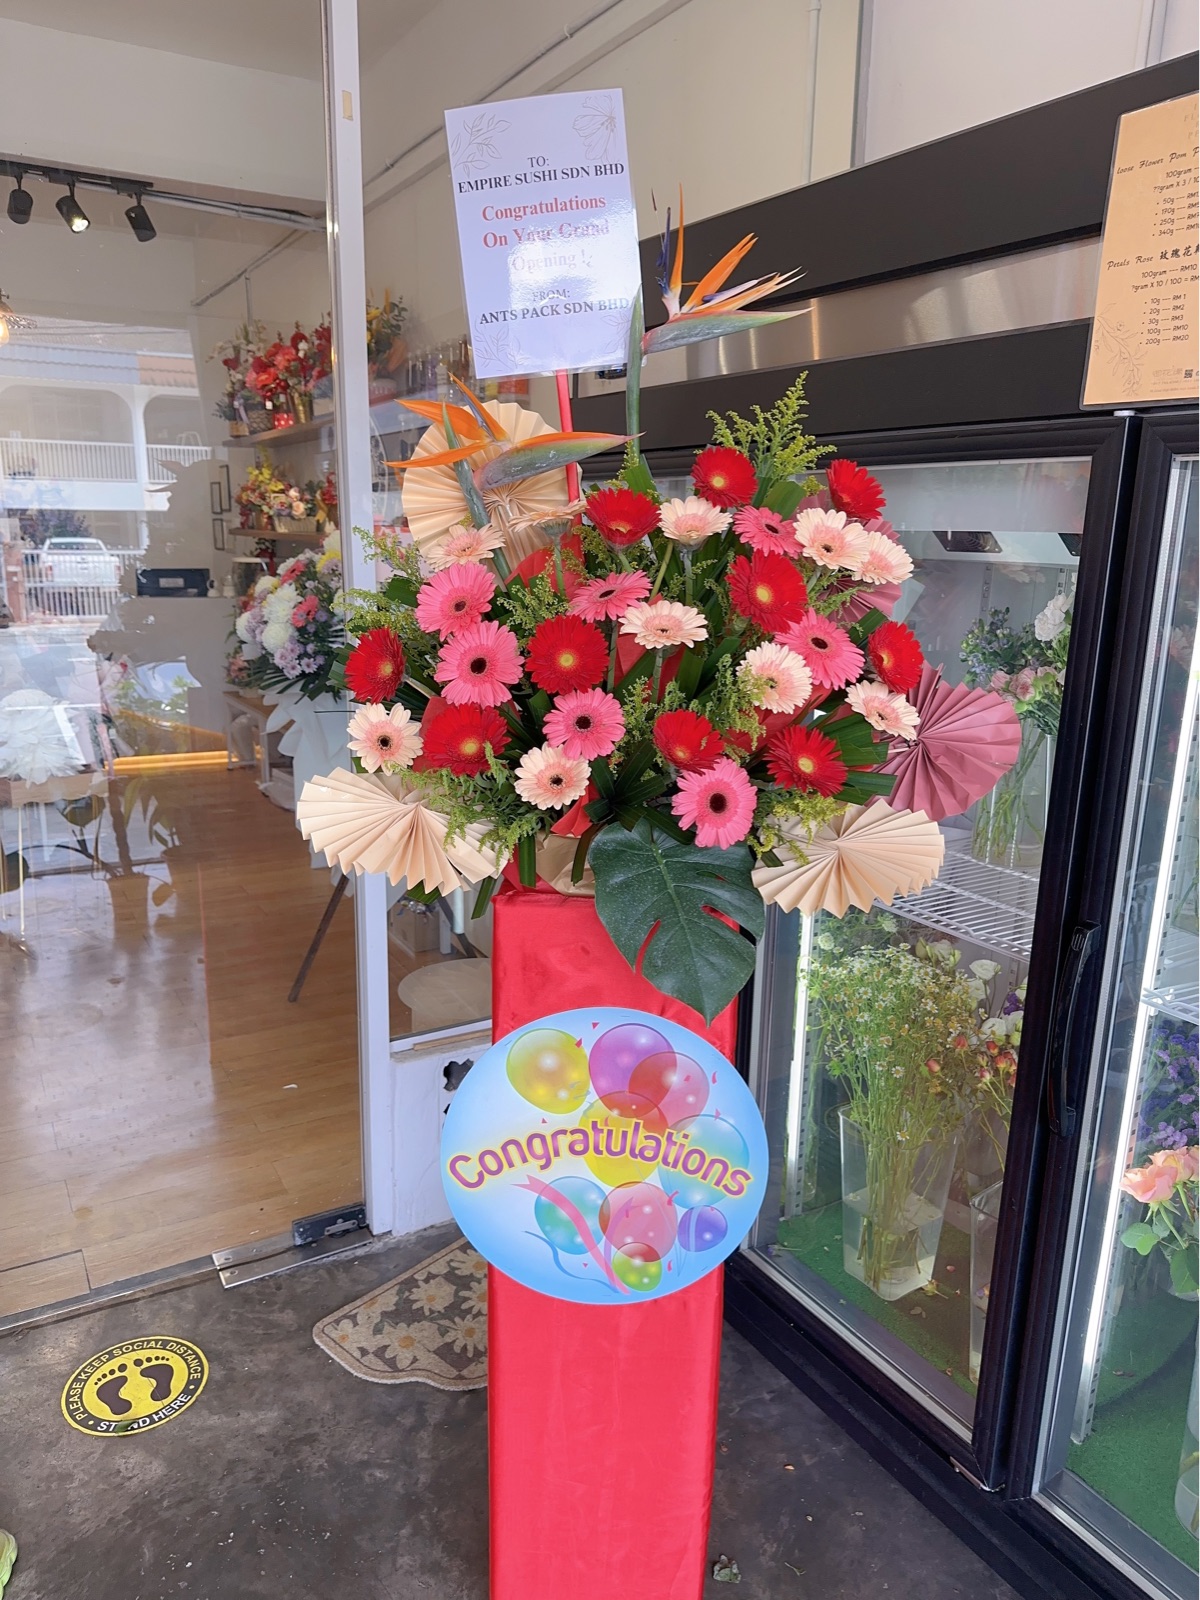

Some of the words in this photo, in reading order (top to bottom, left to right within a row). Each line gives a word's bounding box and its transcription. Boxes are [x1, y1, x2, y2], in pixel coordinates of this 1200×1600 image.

[527, 156, 550, 168] TO:
[1139, 158, 1164, 169] Flower
[1169, 152, 1187, 163] Pom
[458, 175, 512, 194] EMPIRE
[514, 170, 558, 186] SUSHI
[561, 166, 591, 180] SDN
[594, 163, 625, 177] BHD
[1166, 168, 1192, 178] 100gram
[482, 195, 606, 222] Congratulations
[483, 231, 508, 249] On
[513, 227, 552, 244] Your
[559, 218, 610, 239] Grand
[512, 252, 577, 274] Opening
[1107, 258, 1130, 270] Petals
[1135, 255, 1154, 264] Rose
[1141, 269, 1167, 279] 100gram
[1180, 263, 1198, 272] RM10
[1170, 277, 1182, 285] 100
[532, 288, 571, 302] FROM:
[1150, 297, 1161, 305] 10g
[479, 308, 518, 325] ANTS
[521, 304, 561, 319] PACK
[563, 301, 594, 315] SDN
[598, 297, 630, 311] BHD
[1149, 307, 1160, 316] 20g
[1148, 317, 1159, 326] 30g
[1147, 327, 1161, 336] 100g
[1145, 337, 1161, 346] 200g
[448, 1119, 753, 1198] Congratulations
[68, 1382, 88, 1421] PLEASE
[78, 1354, 110, 1380] KEEP
[112, 1340, 164, 1357] SOCIAL
[166, 1341, 202, 1380] DISTANCE
[97, 1417, 150, 1432] STND
[152, 1393, 192, 1422] HERE
